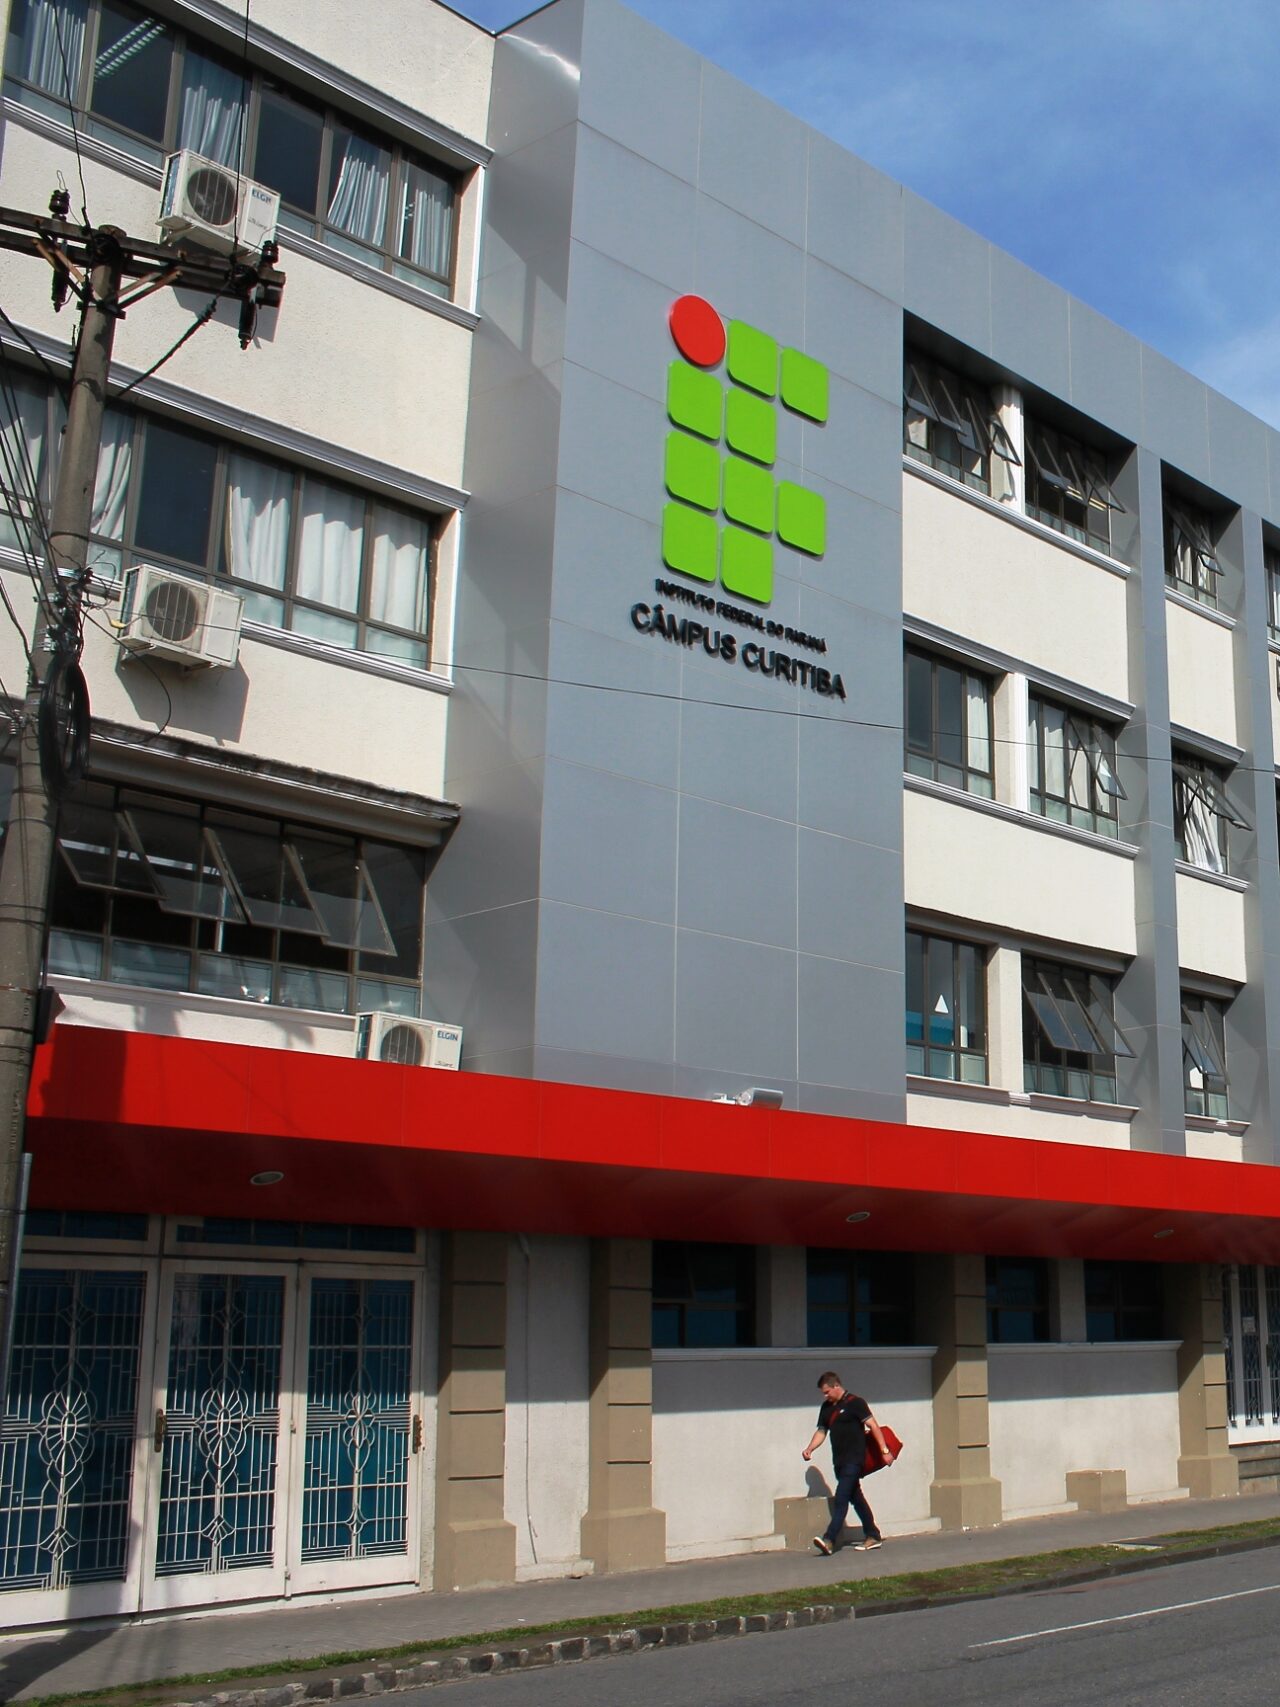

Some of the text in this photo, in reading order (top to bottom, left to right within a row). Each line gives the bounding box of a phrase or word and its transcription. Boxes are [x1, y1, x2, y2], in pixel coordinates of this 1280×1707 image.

[716, 601, 766, 631] FEDERAL
[766, 620, 784, 636] DO
[631, 602, 847, 700] CÂMPUS CURITIBA
[437, 1030, 459, 1041] ELGIN
